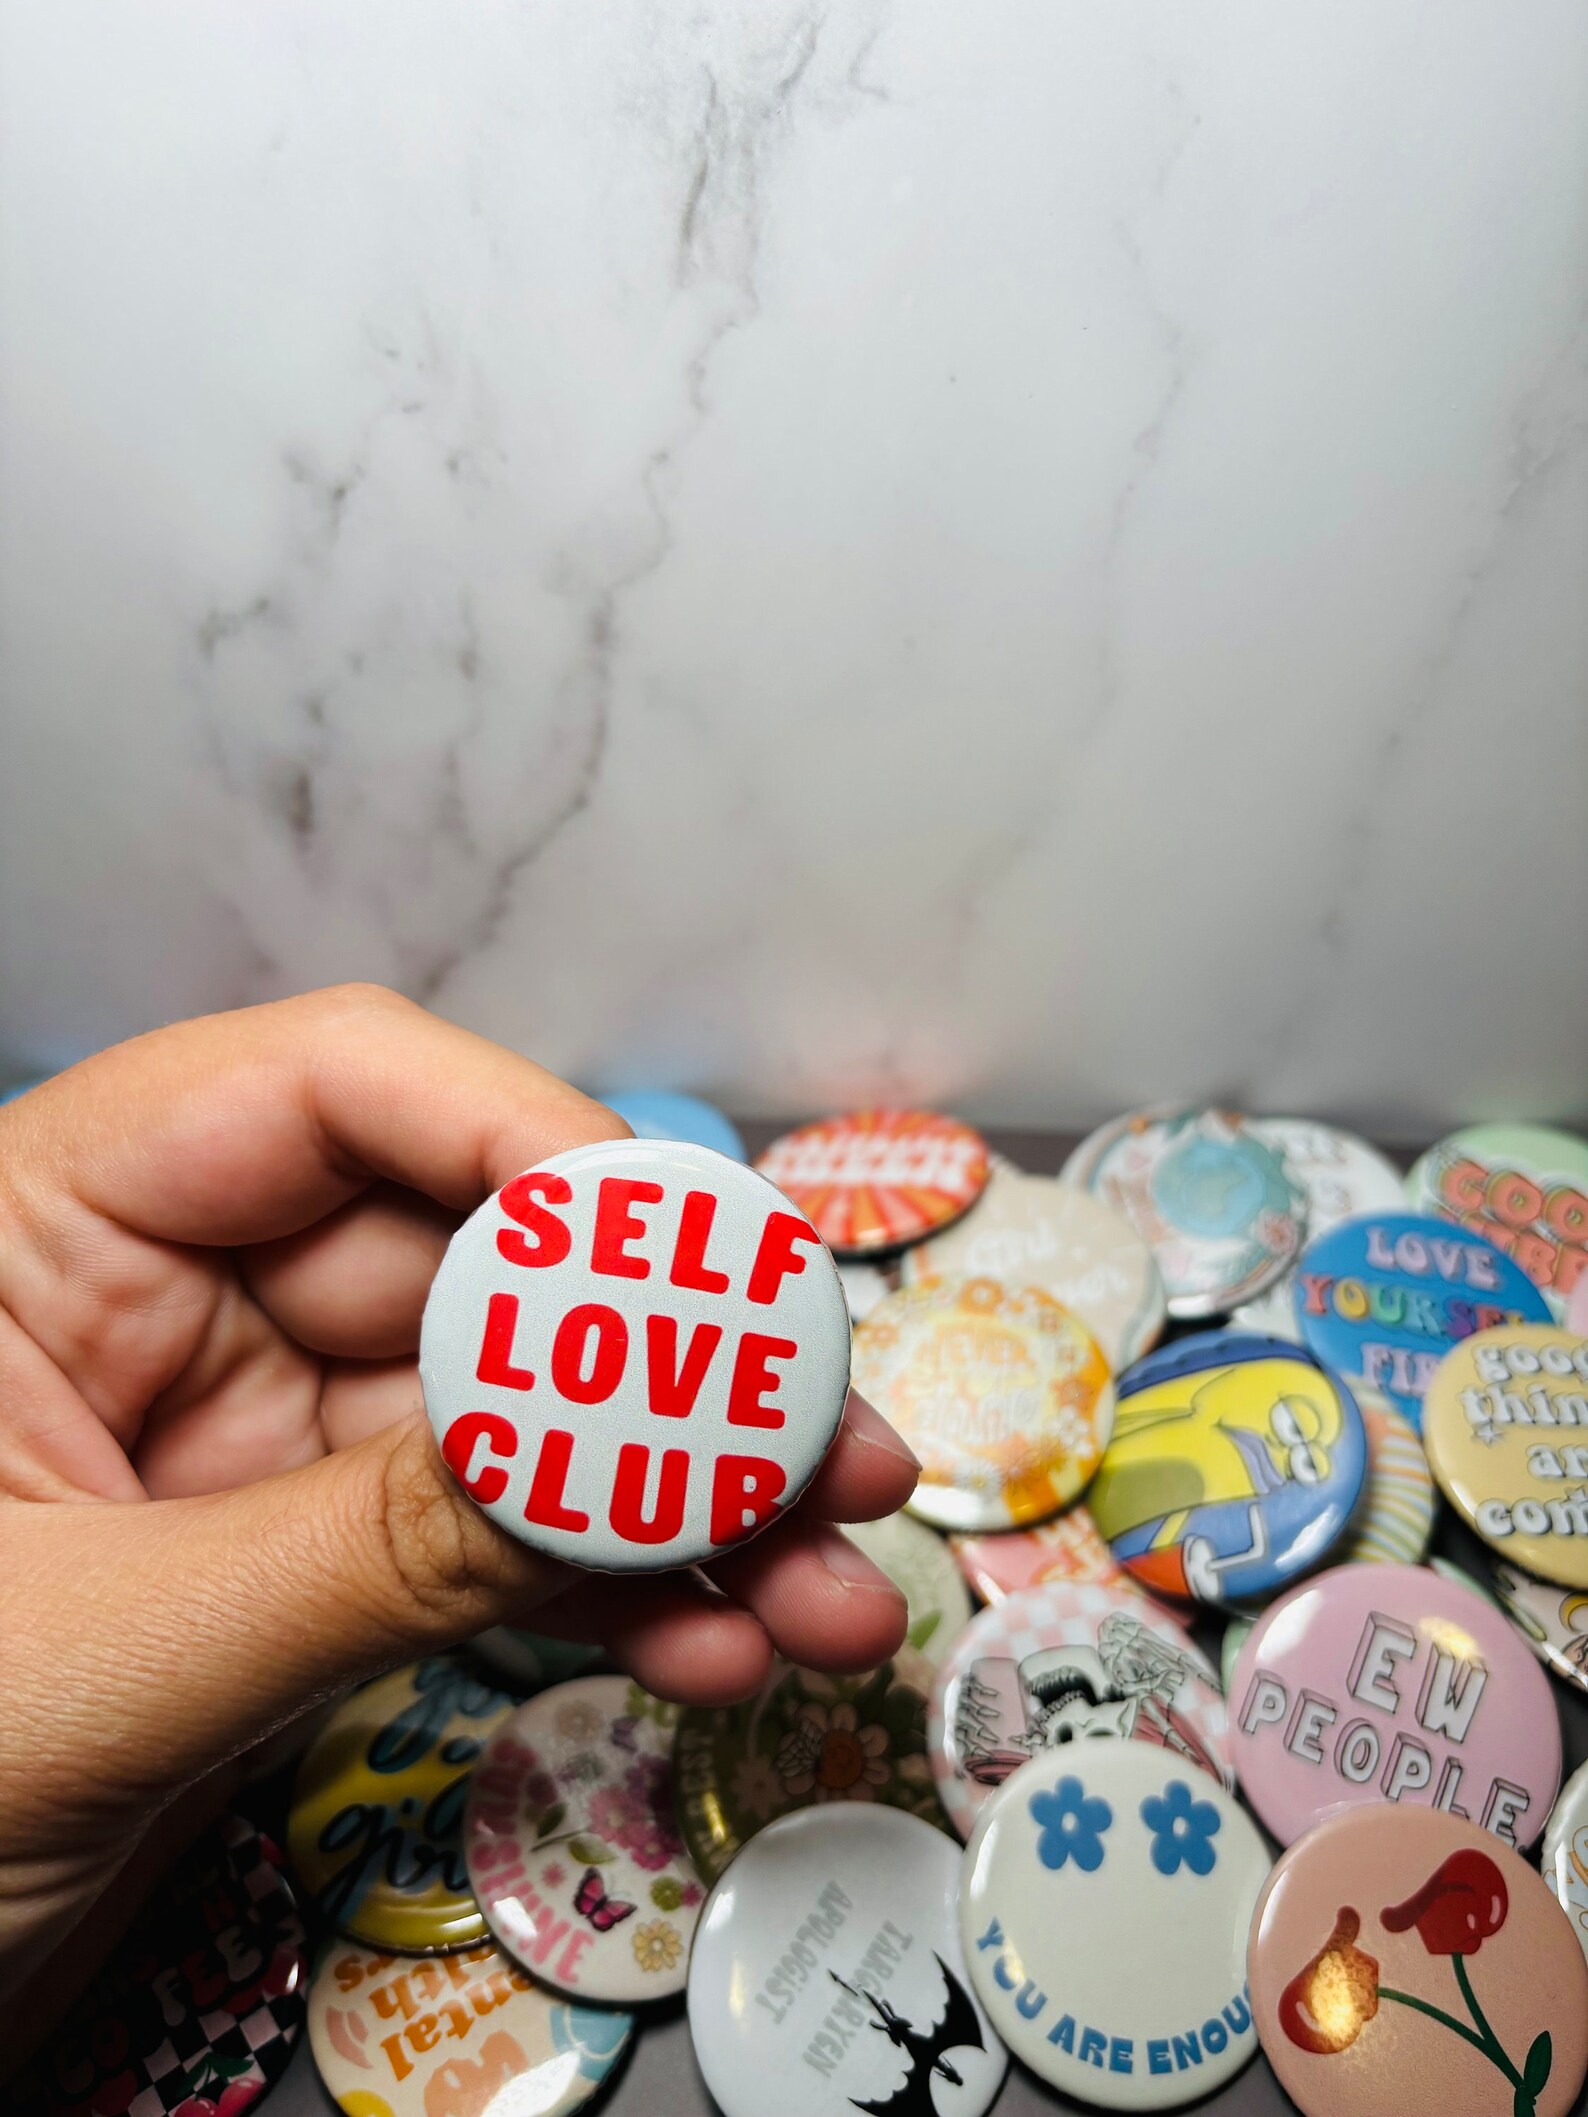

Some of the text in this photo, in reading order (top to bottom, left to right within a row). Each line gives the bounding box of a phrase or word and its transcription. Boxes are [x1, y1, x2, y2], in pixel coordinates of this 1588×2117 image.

[496, 1172, 821, 1305] SELF
[1366, 1226, 1499, 1290] LOVE
[476, 1292, 797, 1429] LOVE
[442, 1411, 787, 1546] CLUB
[1346, 1610, 1489, 1744] EW
[1046, 2013, 1133, 2075] ARE
[1147, 1980, 1250, 2075] ENOU
